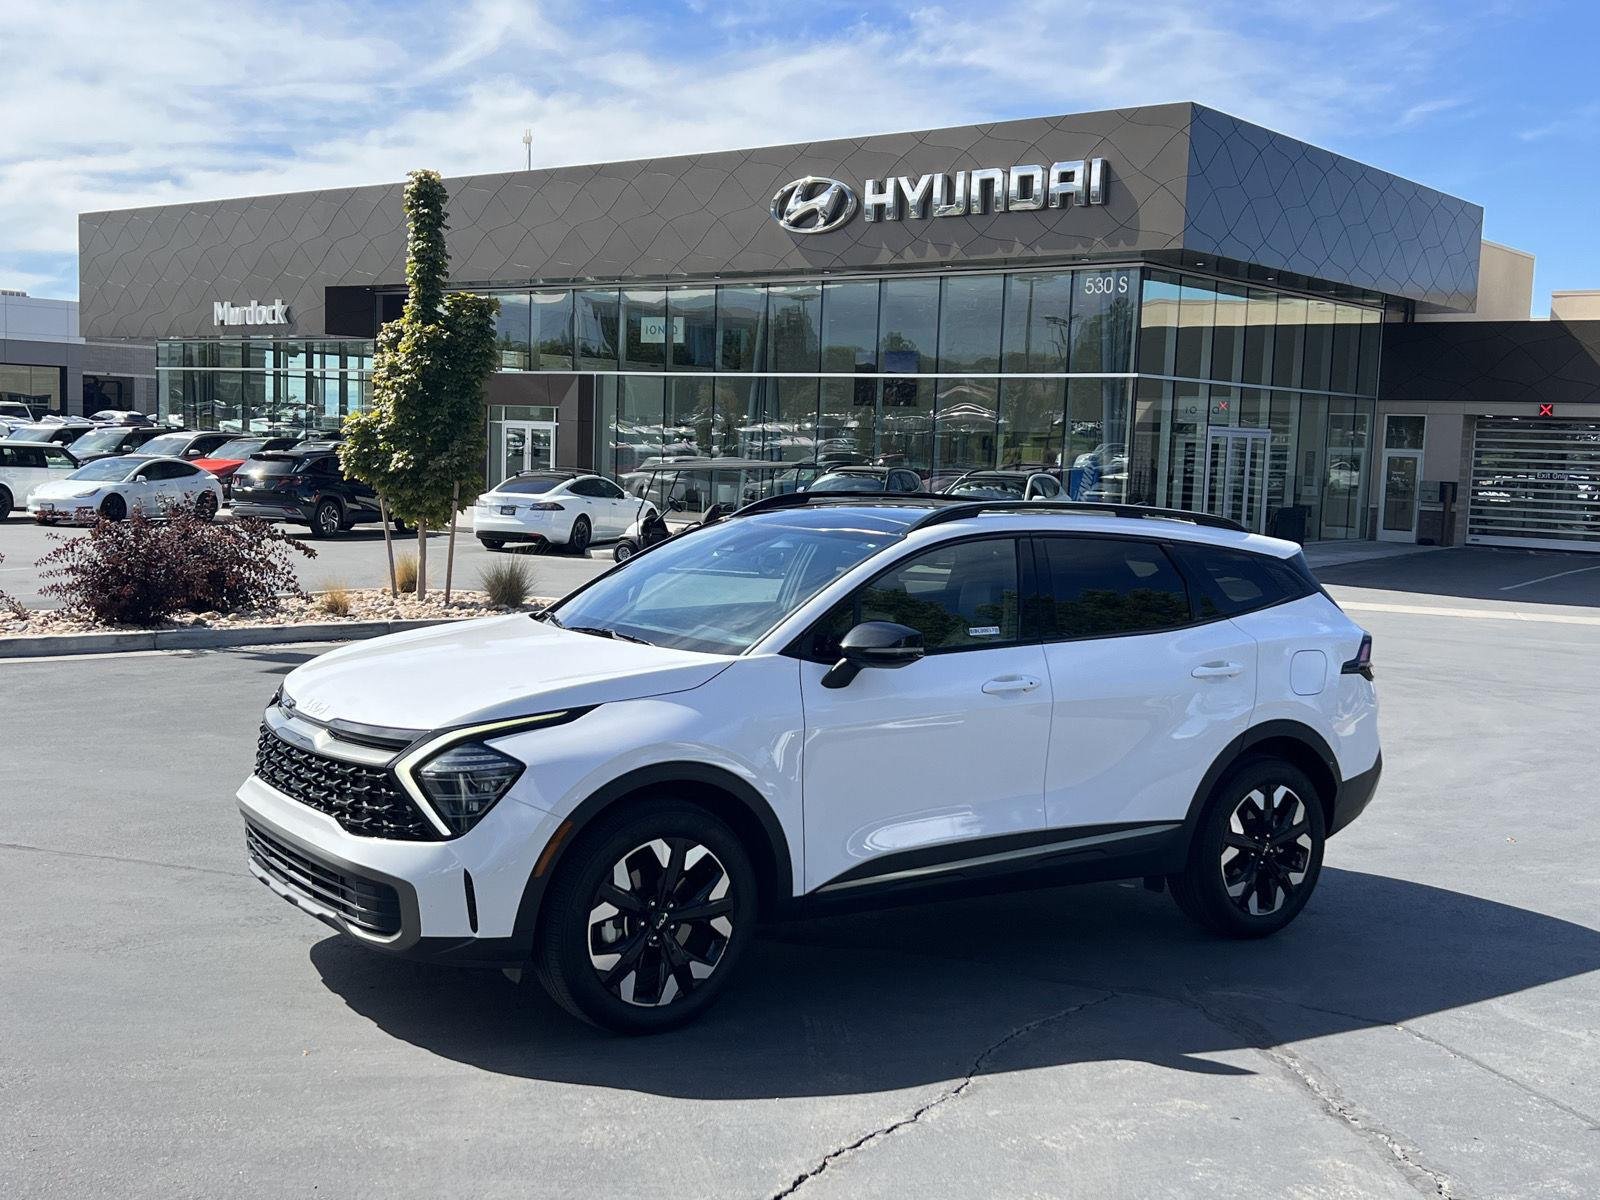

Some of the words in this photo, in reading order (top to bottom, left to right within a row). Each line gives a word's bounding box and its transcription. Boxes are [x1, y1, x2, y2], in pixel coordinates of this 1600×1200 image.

[864, 157, 1107, 223] HYUNDAI
[1084, 276, 1114, 295] 530
[1118, 275, 1128, 293] S
[213, 298, 289, 326] Murdock
[645, 324, 678, 335] IONQ
[1536, 471, 1551, 479] Exit
[1552, 472, 1568, 481] Only
